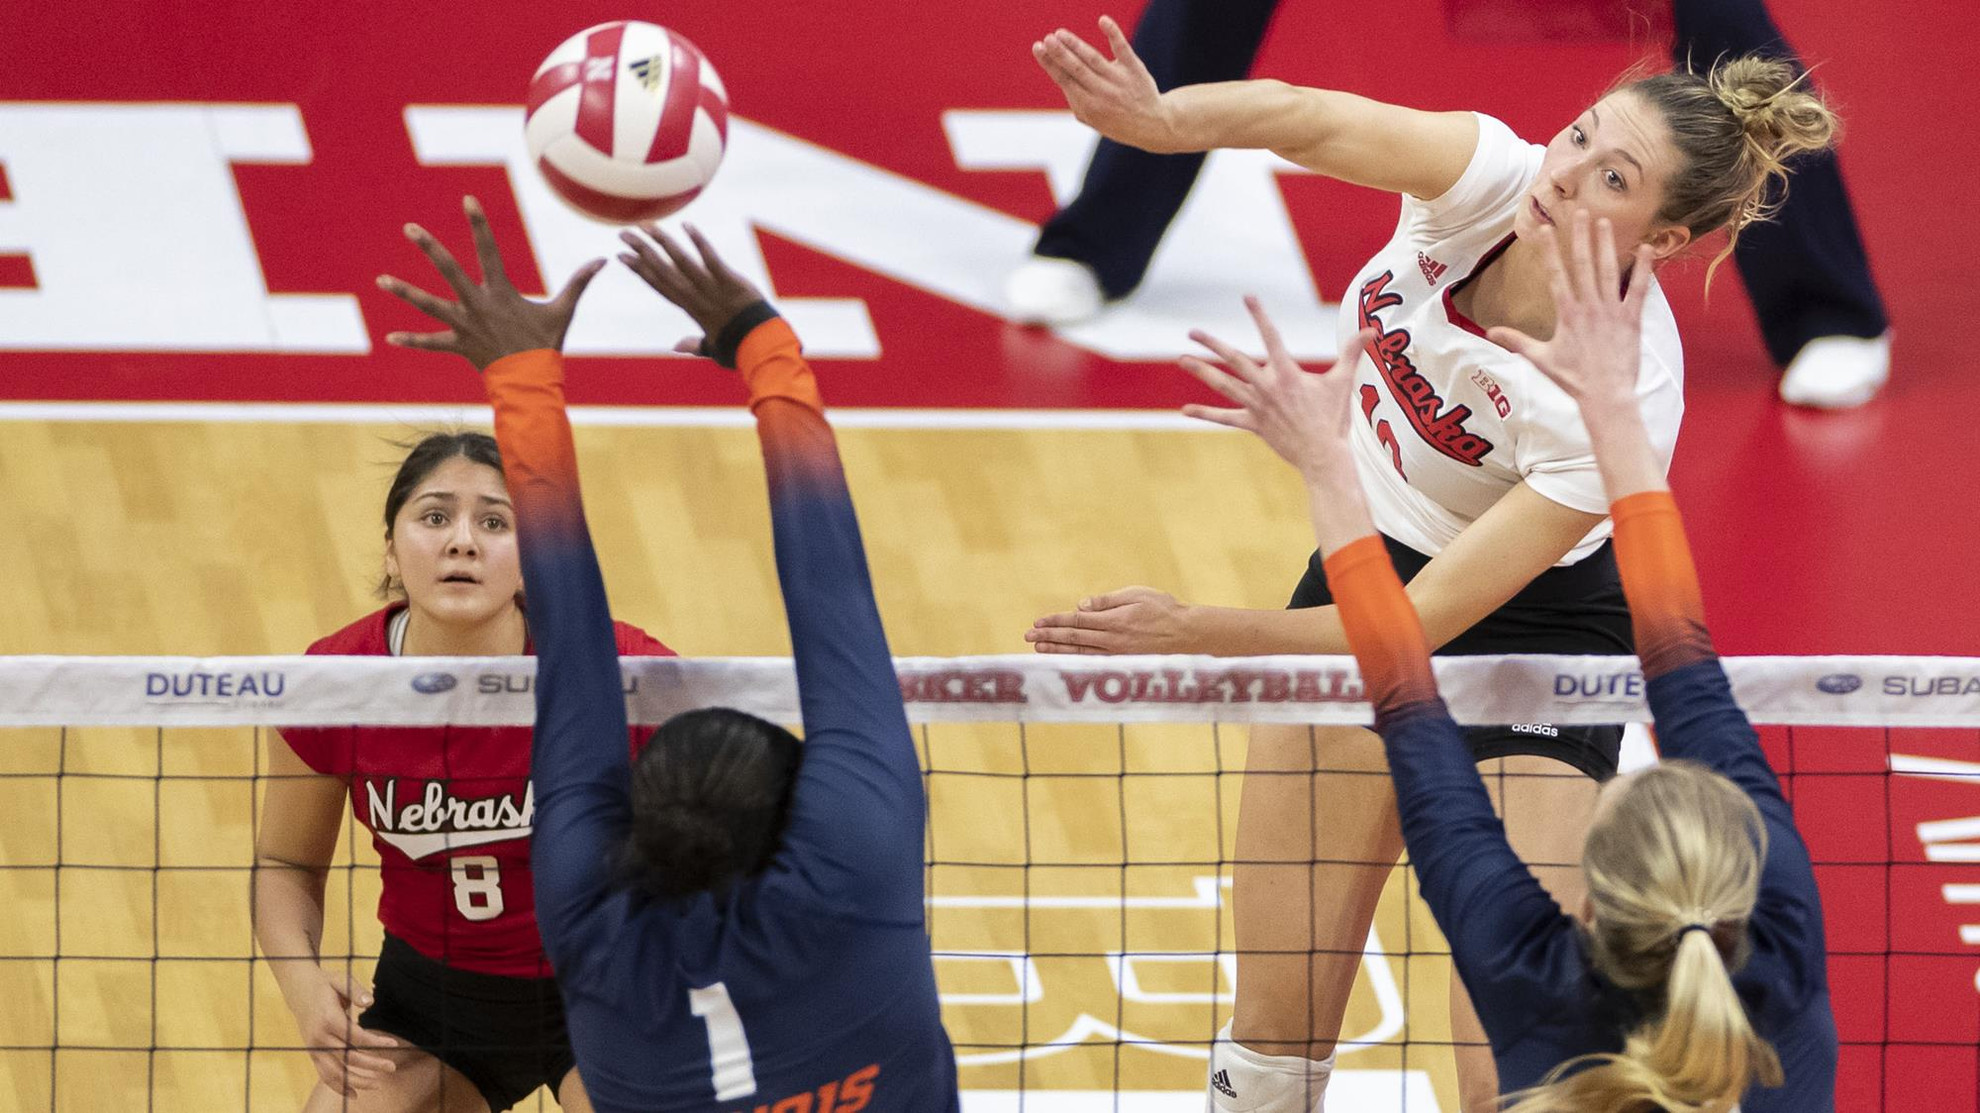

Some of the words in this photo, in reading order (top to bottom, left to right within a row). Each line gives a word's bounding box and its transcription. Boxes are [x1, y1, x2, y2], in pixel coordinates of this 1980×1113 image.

[1418, 251, 1436, 286] adidas
[146, 672, 285, 696] DUTEAU
[1060, 669, 1366, 703] VOLLEYBAL
[1554, 672, 1641, 696] DUTE
[1883, 676, 1980, 696] SUBA
[1511, 721, 1558, 737] adidas
[450, 855, 504, 921] 8
[688, 981, 756, 1102] 1
